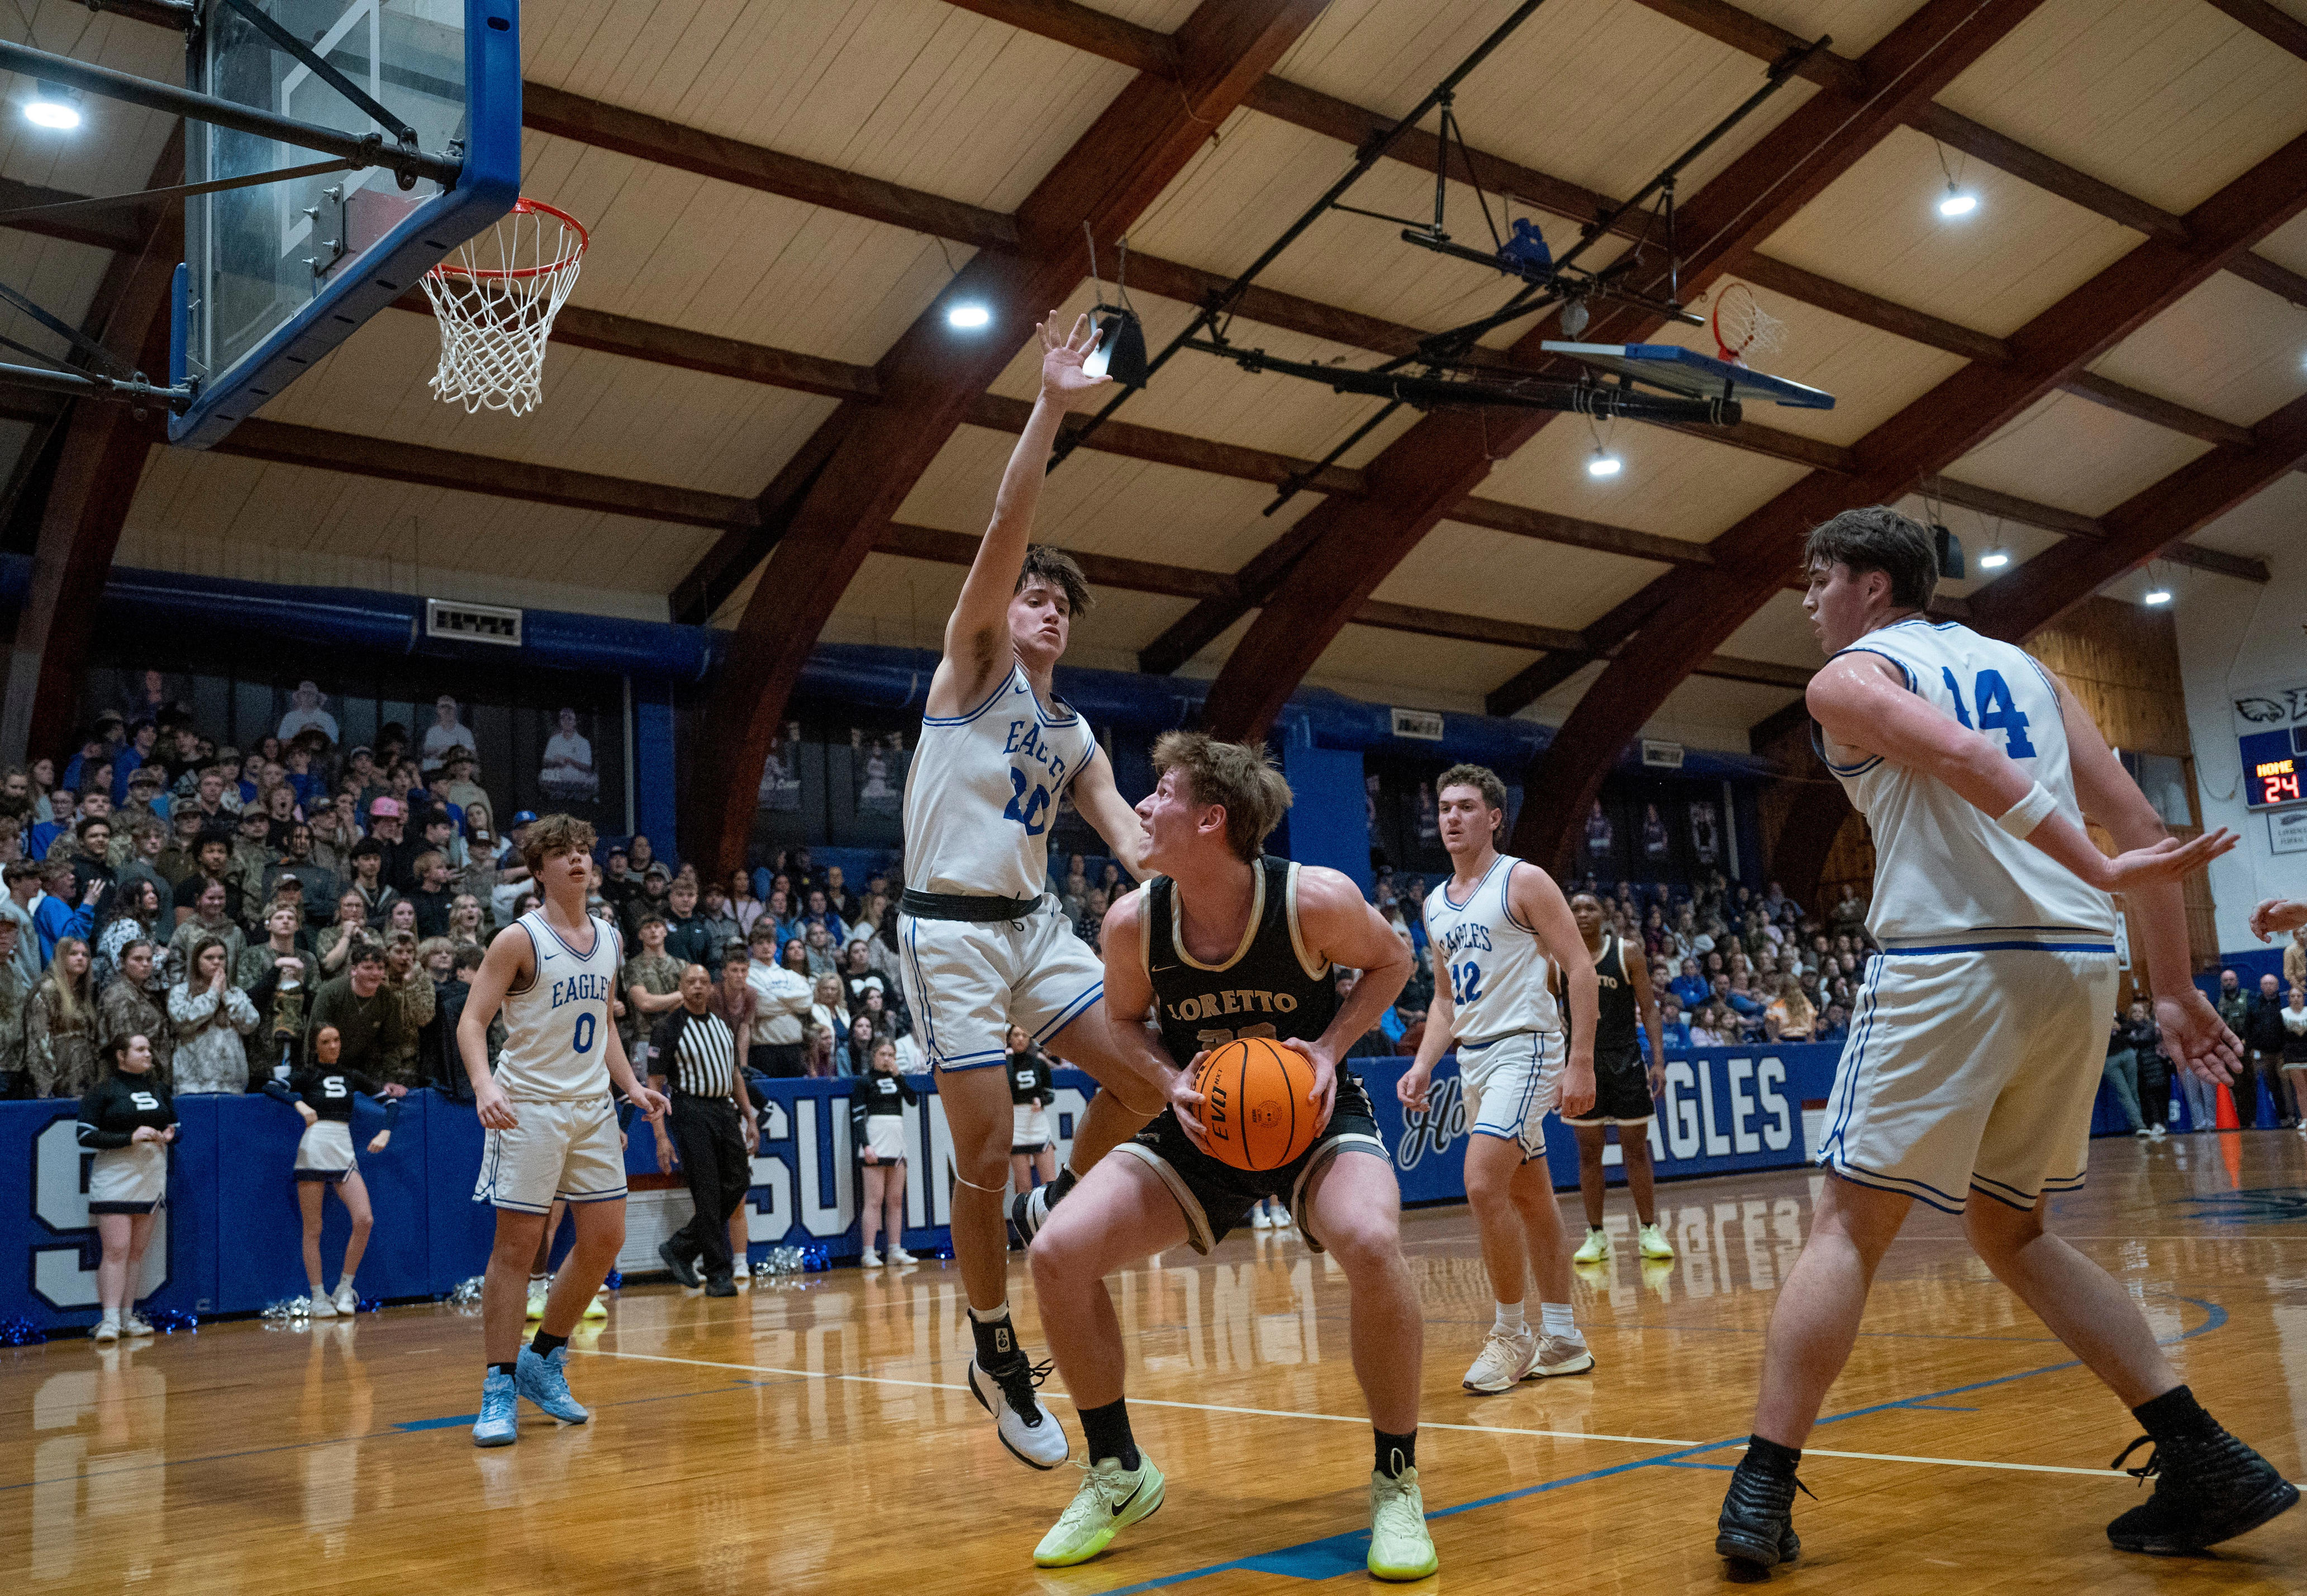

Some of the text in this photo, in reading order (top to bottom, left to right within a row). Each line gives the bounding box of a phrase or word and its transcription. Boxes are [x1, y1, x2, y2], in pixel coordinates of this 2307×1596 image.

[1941, 666, 2037, 759] 14
[2256, 760, 2294, 777] HOME
[2264, 774, 2300, 803] 24
[552, 974, 610, 1009] EAGLE
[1453, 961, 1482, 1006] 12
[573, 1012, 596, 1054] 0
[323, 1076, 347, 1098] S
[876, 1077, 897, 1094] S
[1016, 1070, 1036, 1089] S
[131, 1091, 159, 1111] S
[1211, 1085, 1229, 1141] EVO
